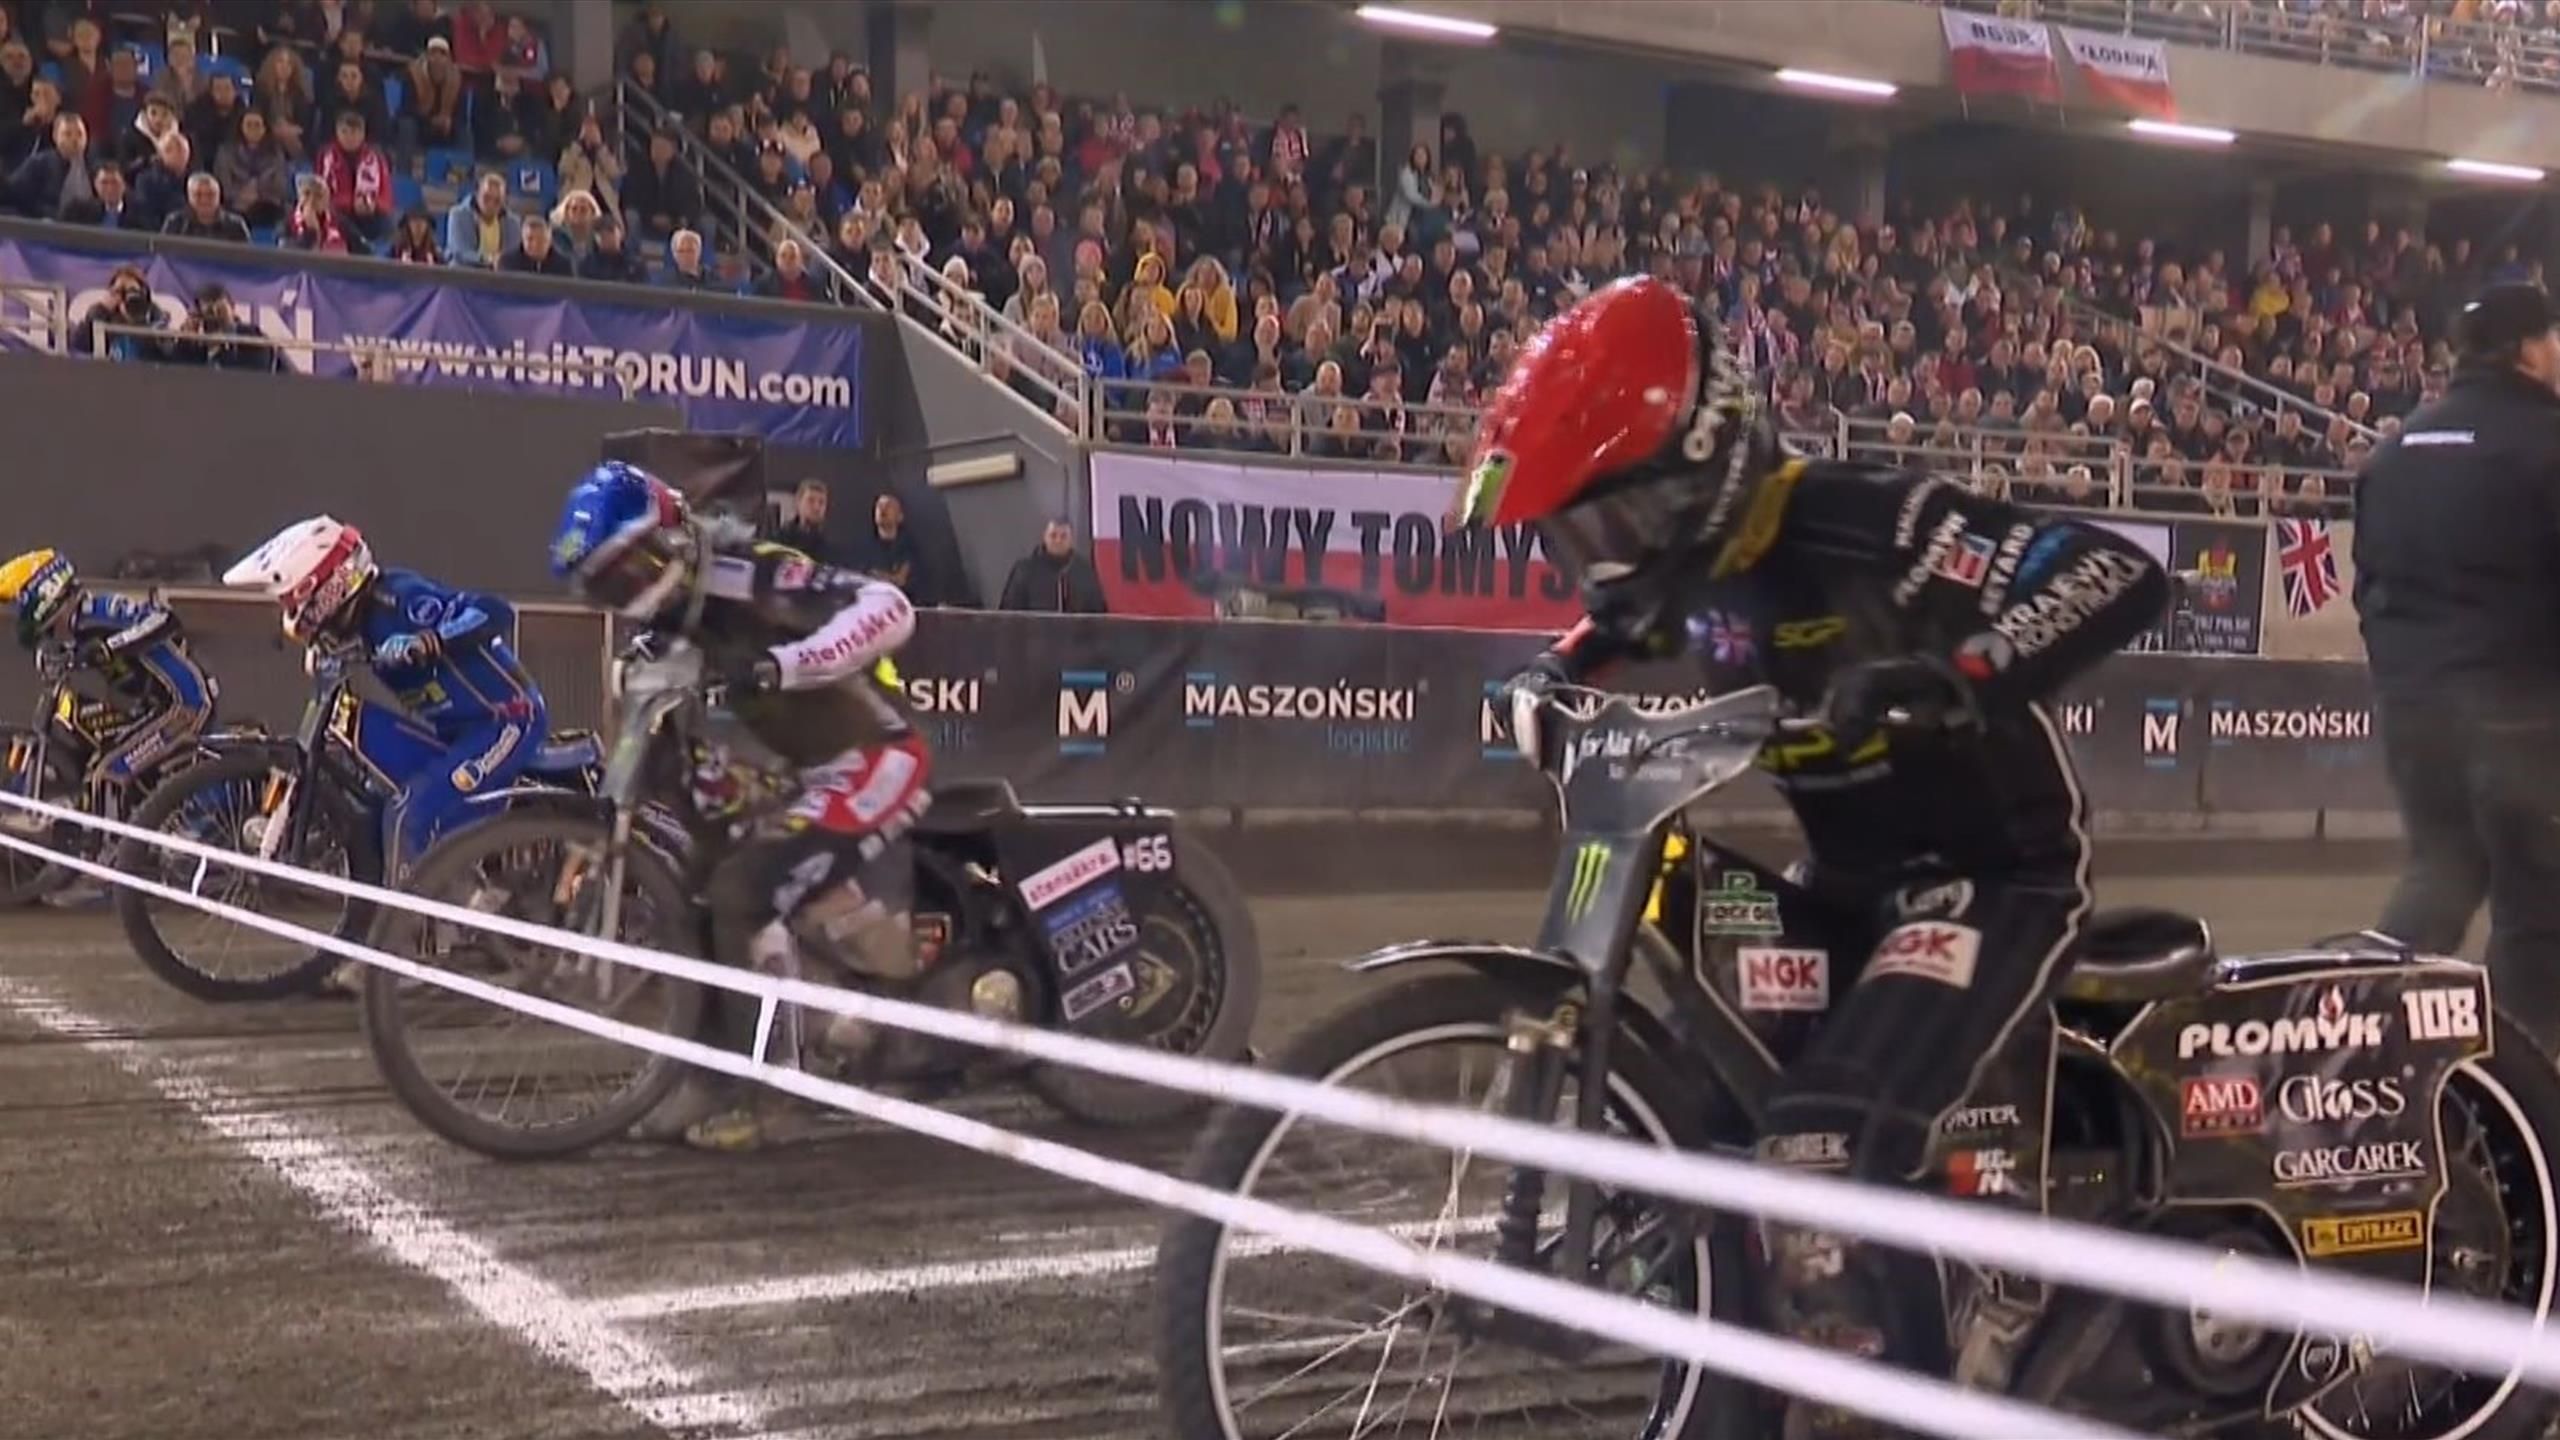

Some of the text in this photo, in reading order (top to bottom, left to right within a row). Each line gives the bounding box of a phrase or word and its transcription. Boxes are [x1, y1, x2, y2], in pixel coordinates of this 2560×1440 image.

[1118, 495, 1336, 597] NOWY
[902, 676, 980, 713] SKI
[1185, 676, 1415, 722] MASZOŃSKI
[2060, 703, 2095, 734] KI
[2143, 711, 2179, 755] M
[2210, 703, 2371, 739] MASZOŃSKI
[1326, 723, 1412, 757] logistic
[1750, 955, 1819, 990] NGK
[2402, 987, 2480, 1041] 108
[2186, 1081, 2259, 1114] AMD
[2273, 1141, 2424, 1180] GARCAREK
